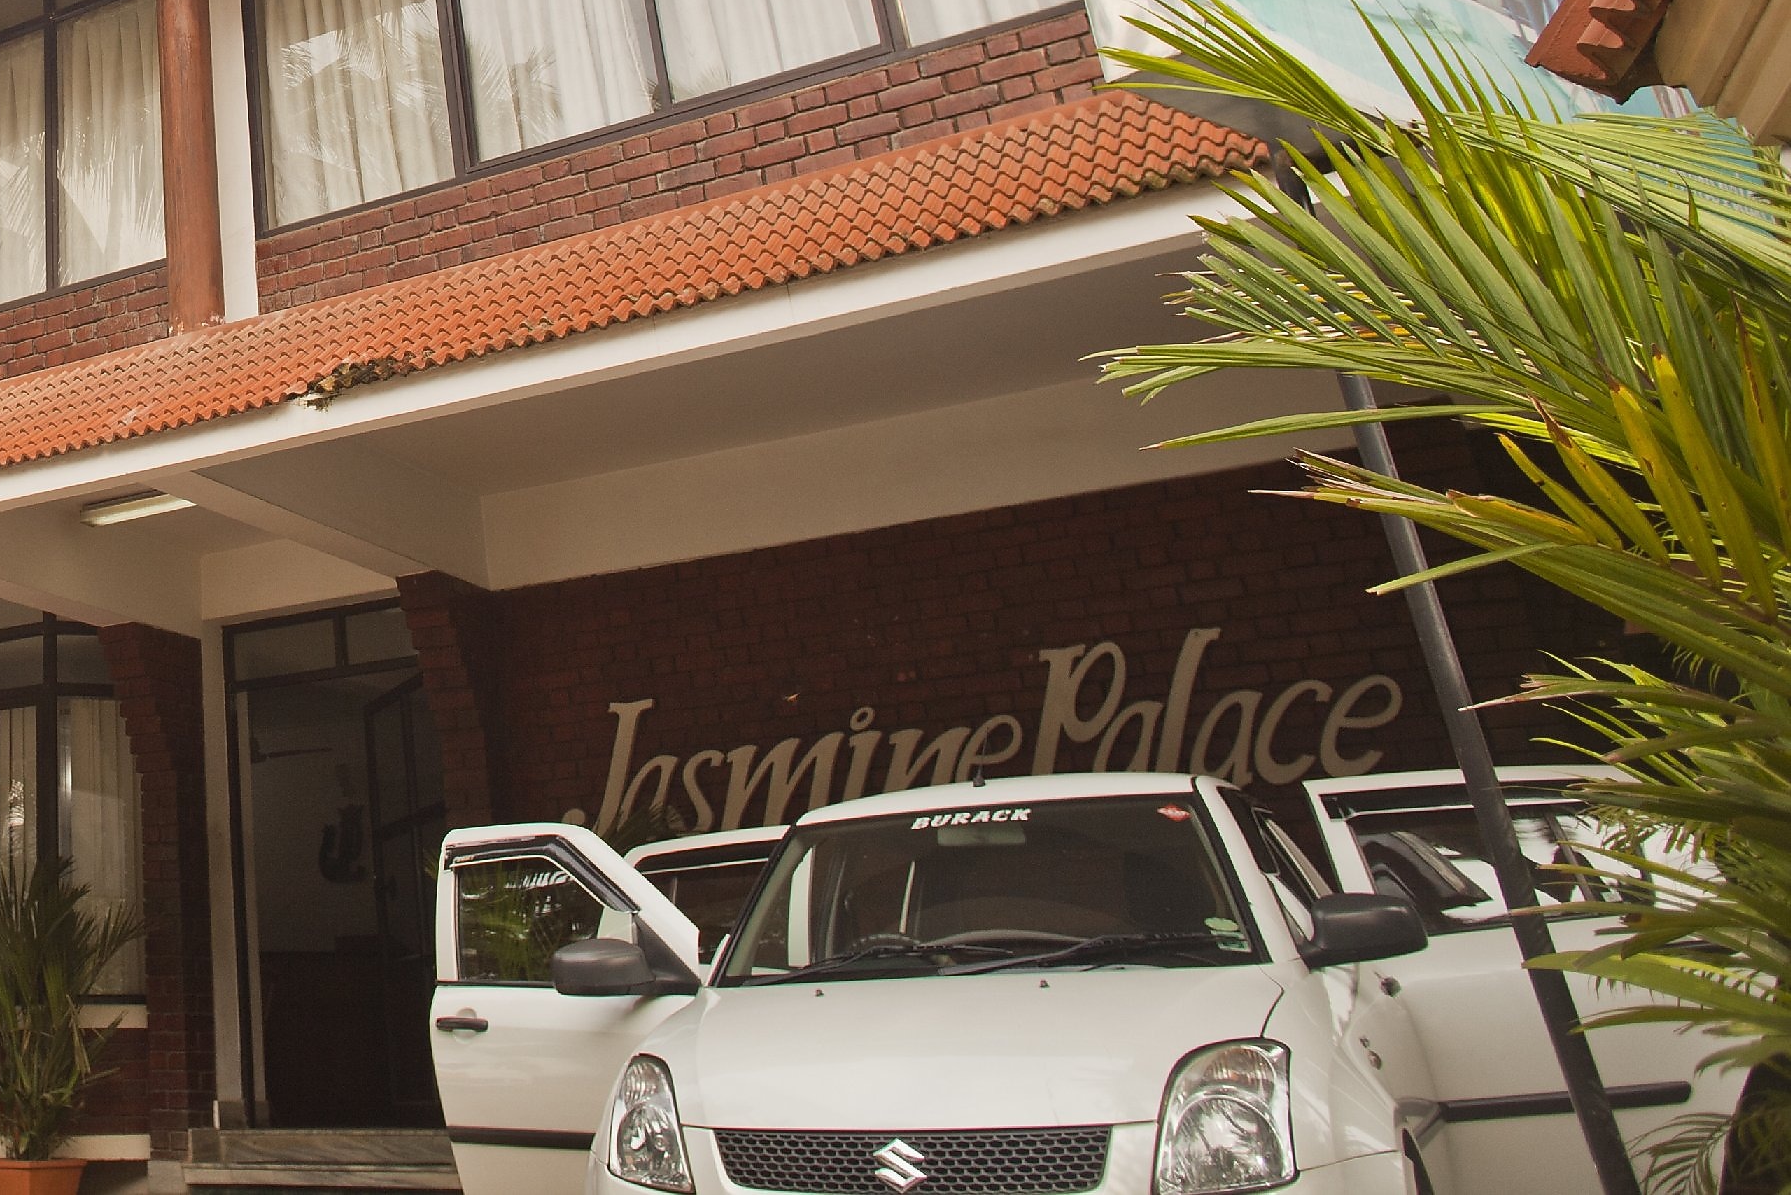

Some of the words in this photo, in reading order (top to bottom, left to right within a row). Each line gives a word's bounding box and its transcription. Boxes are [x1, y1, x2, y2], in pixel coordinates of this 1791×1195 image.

[562, 699, 1023, 835] Jasmine
[1032, 628, 1403, 788] Palace
[910, 808, 1032, 830] BURACK
